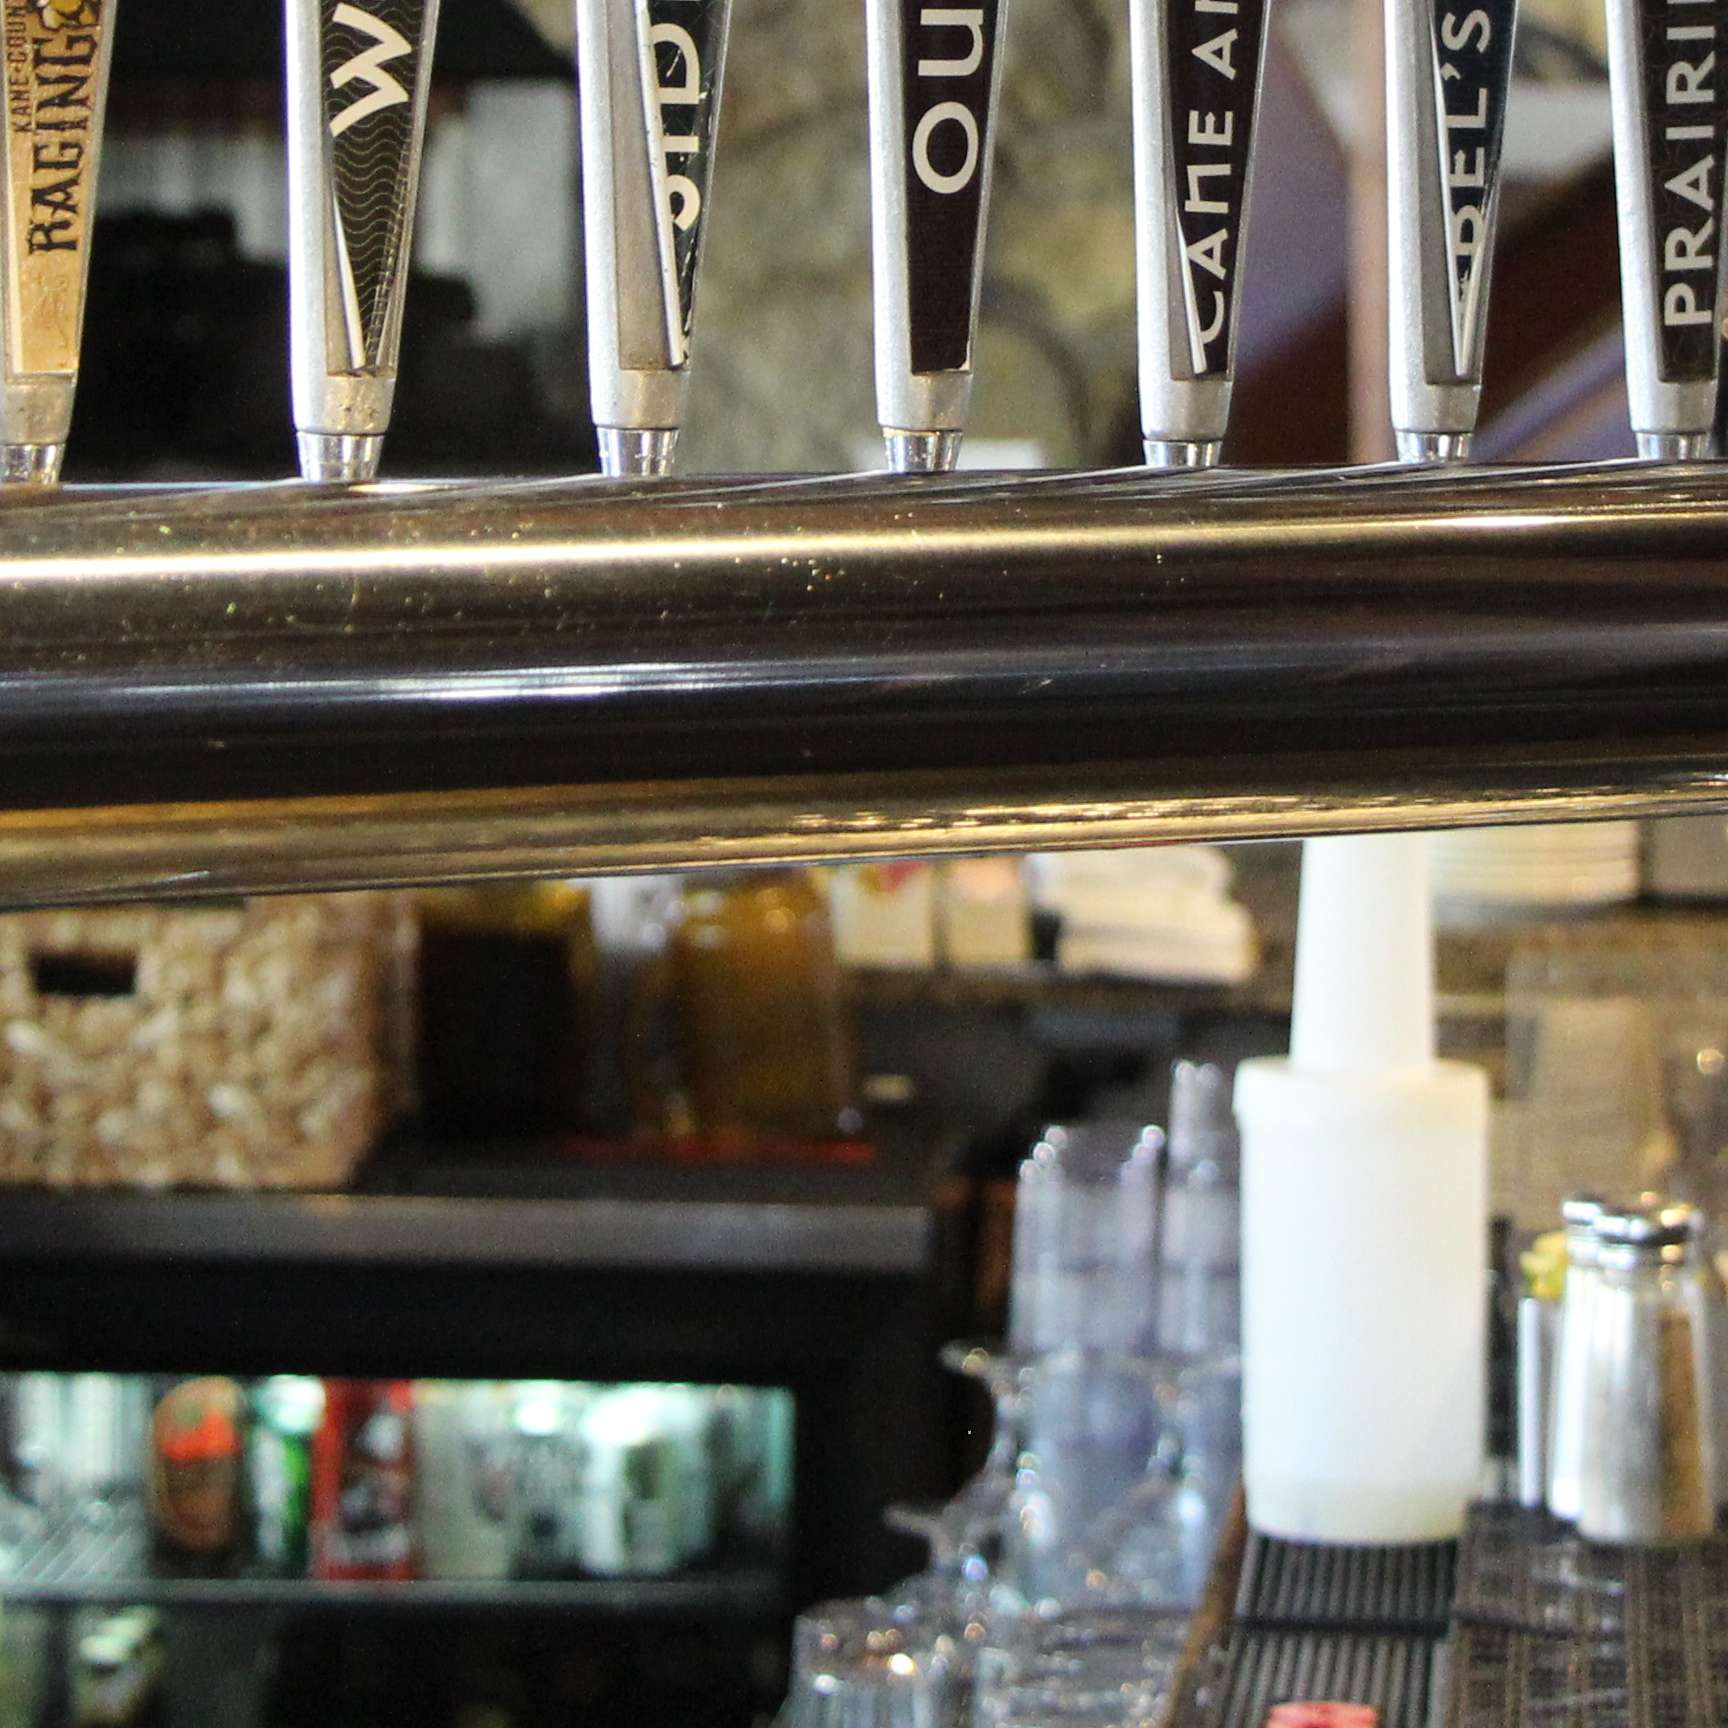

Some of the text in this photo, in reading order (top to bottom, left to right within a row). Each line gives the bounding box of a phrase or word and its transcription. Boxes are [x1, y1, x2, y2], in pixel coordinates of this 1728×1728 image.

[9, 74, 32, 133] KANE
[28, 26, 100, 255] RAGING
[1441, 8, 1490, 313] BEL'S
